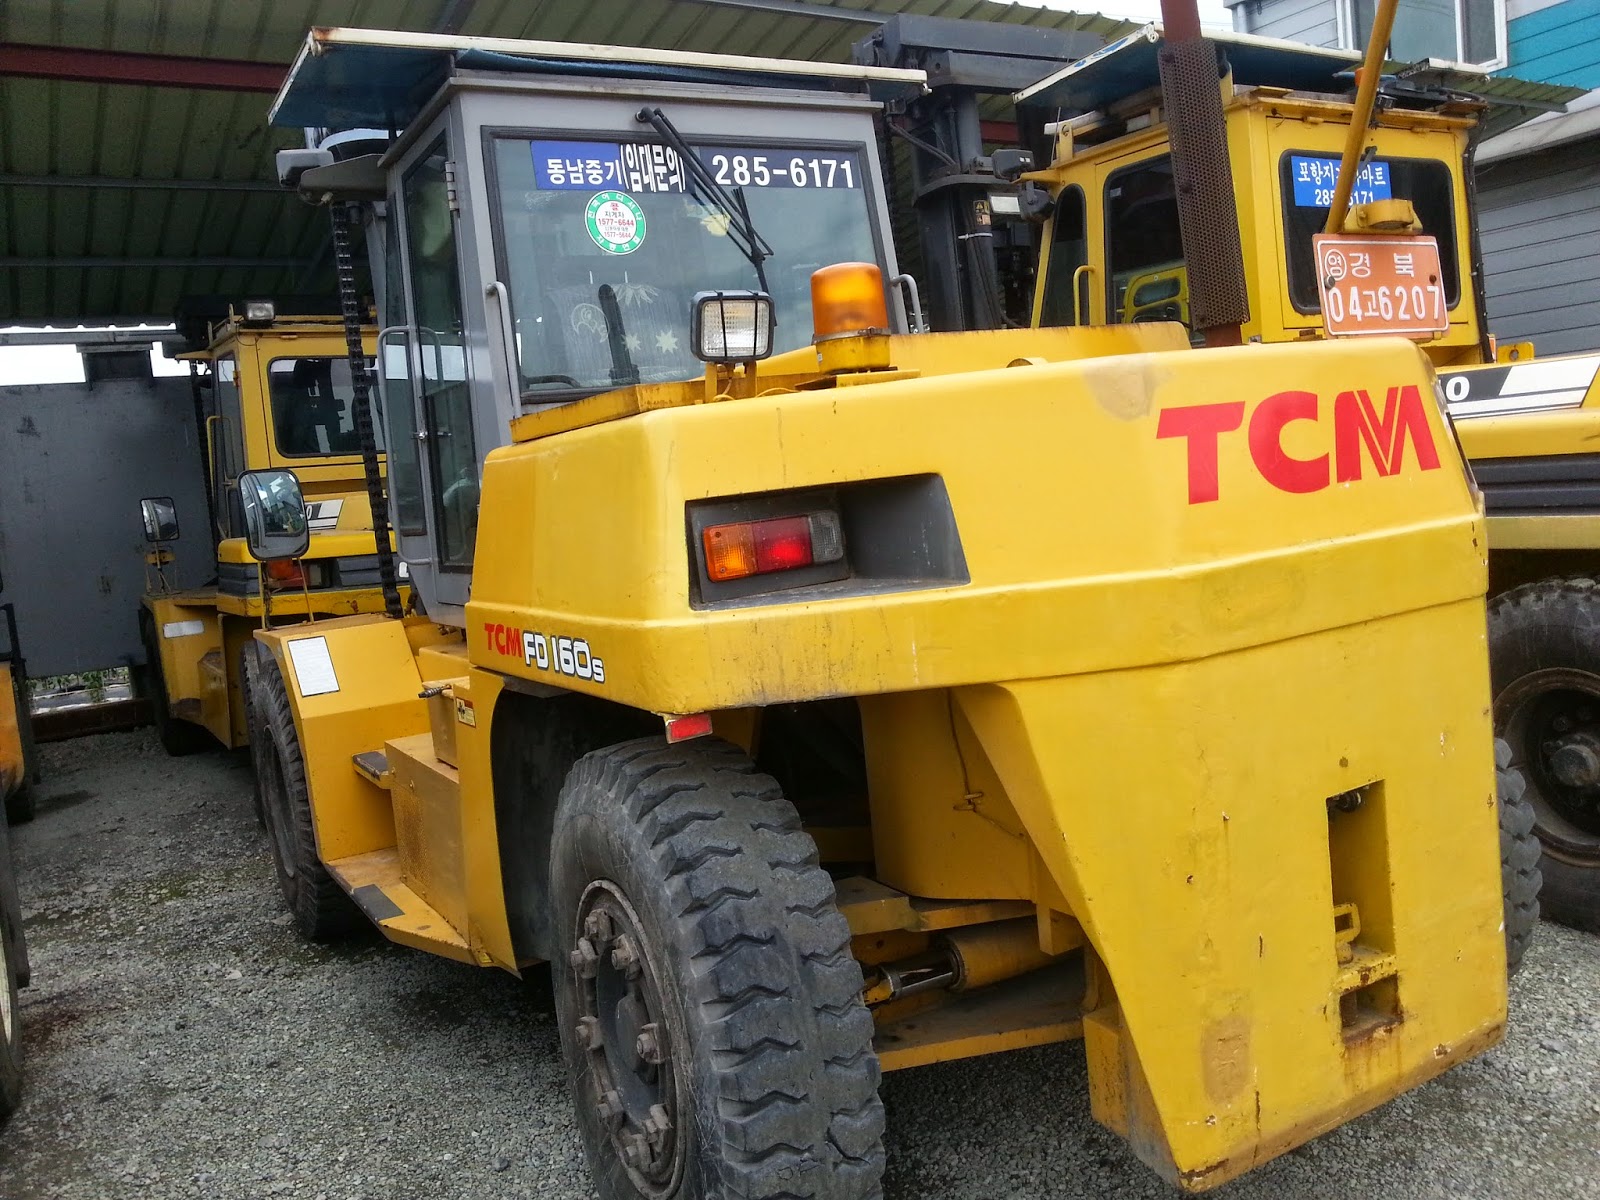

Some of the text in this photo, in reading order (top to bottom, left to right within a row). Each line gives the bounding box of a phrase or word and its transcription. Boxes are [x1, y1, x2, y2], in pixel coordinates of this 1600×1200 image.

[547, 158, 623, 186] 동남중기
[712, 154, 854, 189] 285-6171
[1298, 161, 1386, 188] 포항지마트
[1328, 285, 1440, 323] 04고6207
[1156, 384, 1441, 505] TCM
[484, 622, 522, 658] TCM
